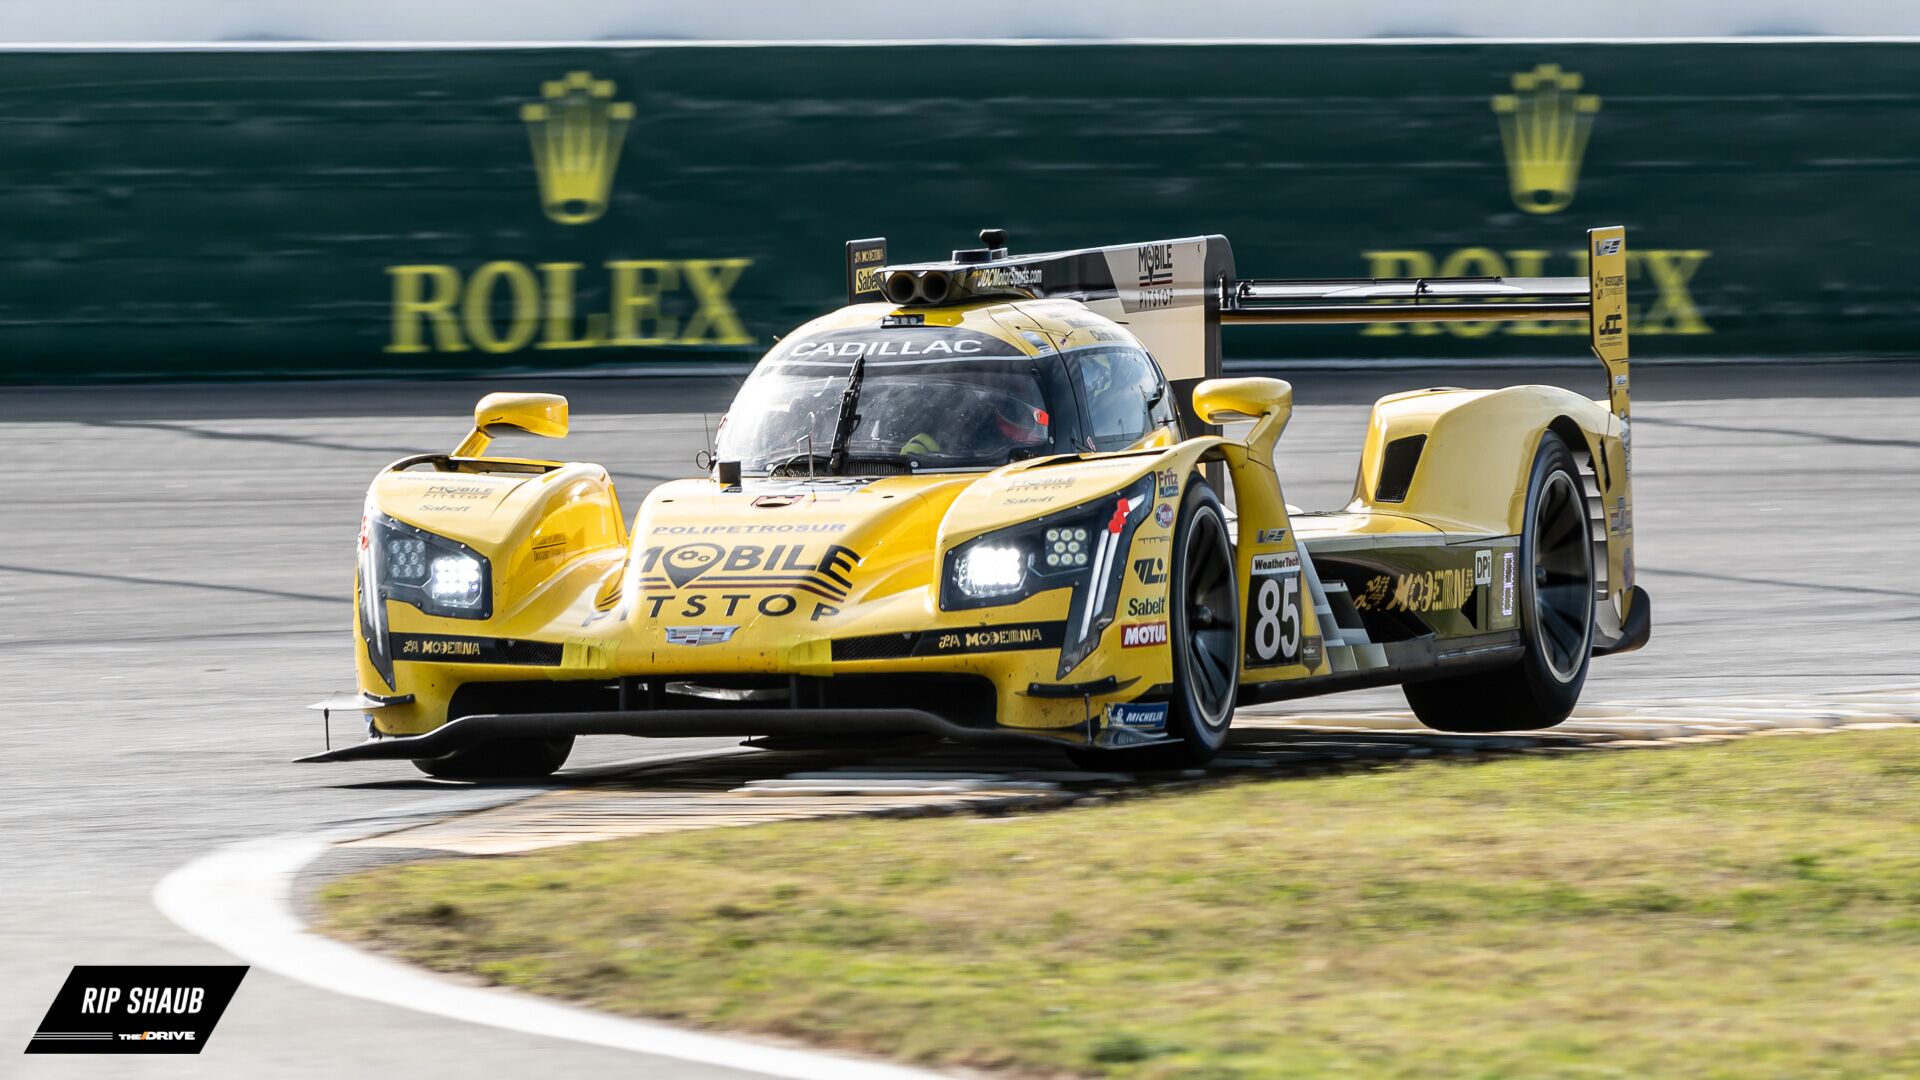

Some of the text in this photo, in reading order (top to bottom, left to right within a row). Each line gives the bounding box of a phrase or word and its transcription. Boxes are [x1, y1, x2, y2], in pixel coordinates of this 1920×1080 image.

[1138, 244, 1173, 272] MOBILE
[857, 269, 879, 292] Sabe
[383, 258, 757, 354] ROLEX
[1139, 288, 1173, 309] PITSTOP
[790, 339, 983, 357] CADILLAC
[651, 523, 848, 535] POLIPETROSUR
[1254, 557, 1300, 570] WeatherTech
[1476, 556, 1491, 579] DPi
[1128, 597, 1166, 617] Sabelt
[1254, 577, 1300, 660] 85
[965, 628, 1042, 647] MODERNA
[1123, 624, 1167, 646] MOTUL
[1125, 711, 1165, 723] MICHELIN
